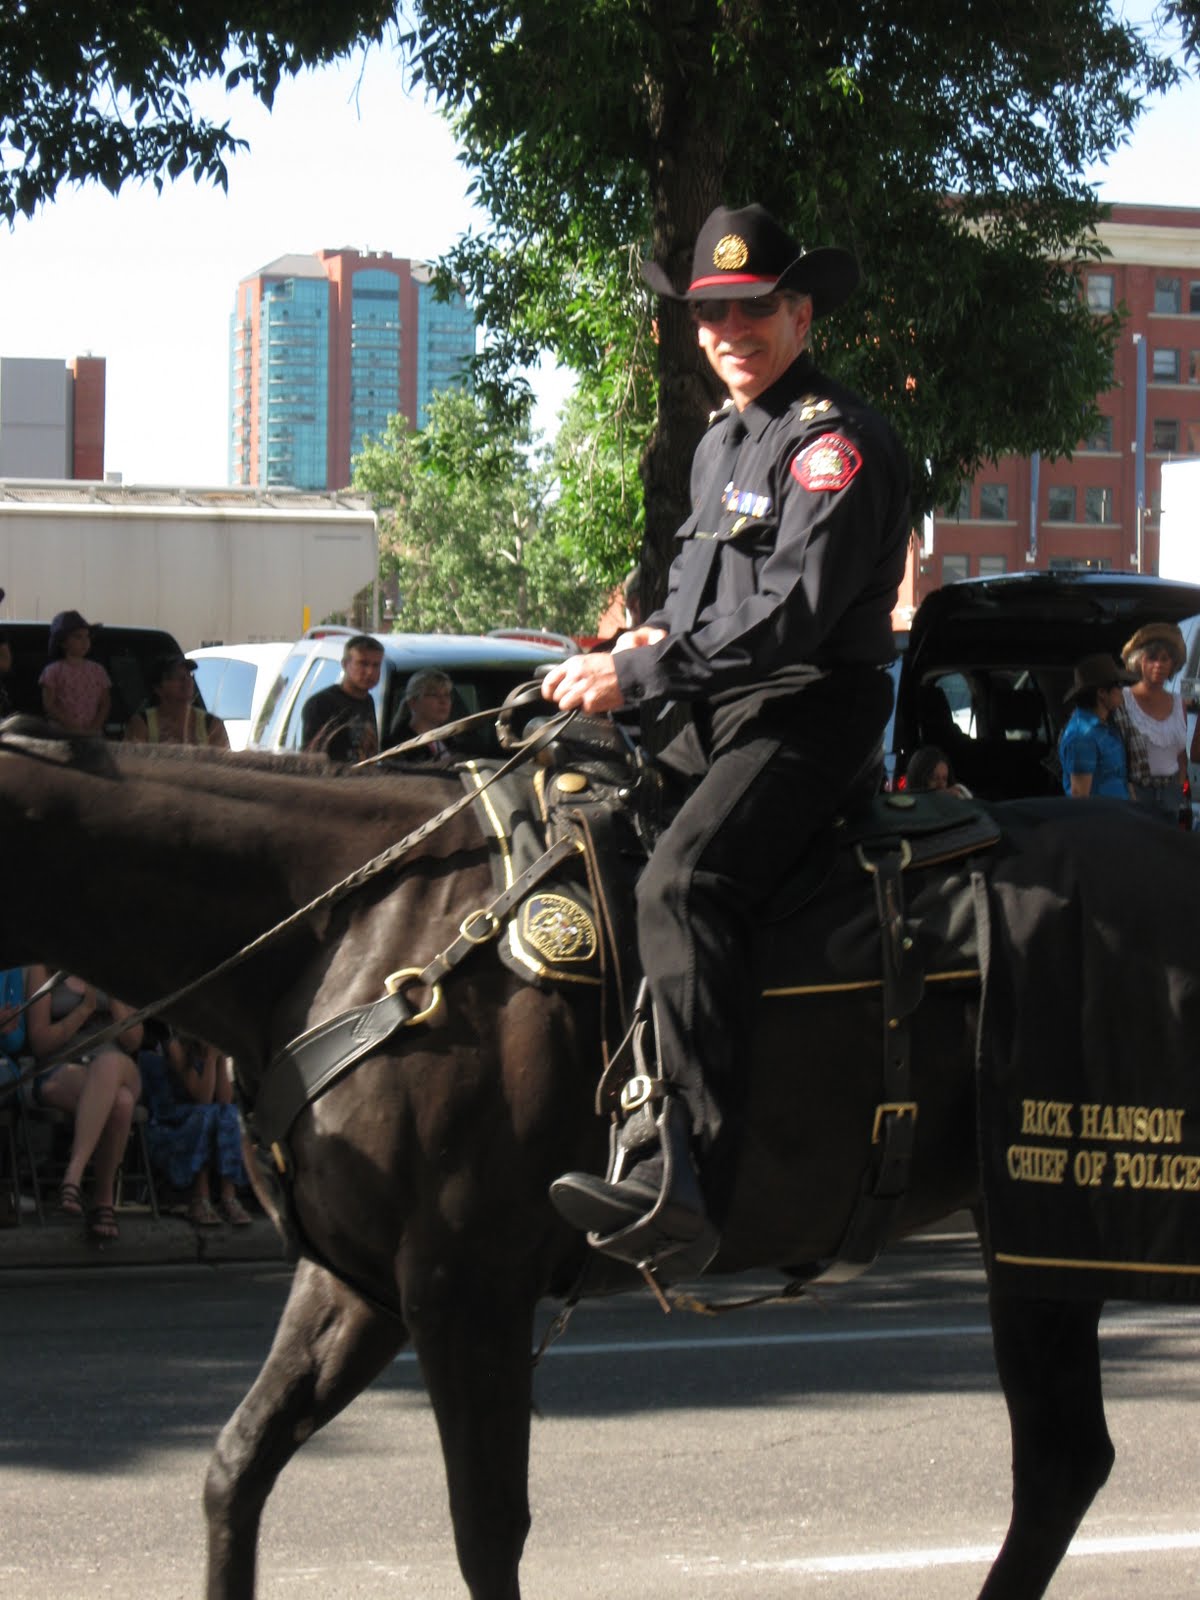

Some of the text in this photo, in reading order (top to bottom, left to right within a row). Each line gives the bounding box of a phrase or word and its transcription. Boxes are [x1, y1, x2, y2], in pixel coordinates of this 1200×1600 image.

[1021, 1099, 1184, 1143] RICK HANSON
[1007, 1145, 1200, 1191] CHIEF OF POLICE
